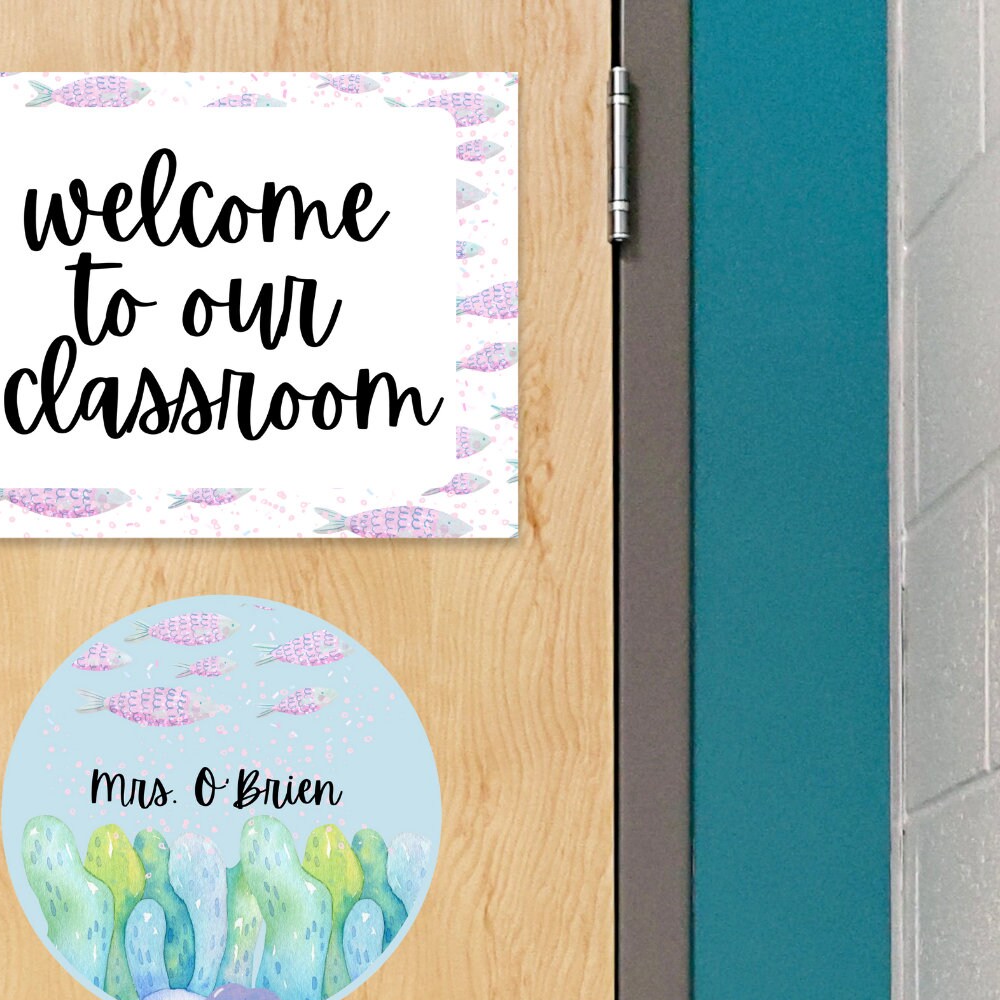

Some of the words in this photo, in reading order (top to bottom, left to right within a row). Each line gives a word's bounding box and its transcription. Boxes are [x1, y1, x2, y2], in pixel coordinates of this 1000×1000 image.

[23, 147, 391, 252] welcome
[64, 251, 158, 347] to
[182, 275, 343, 351] our
[3, 334, 445, 441] classroom
[91, 768, 177, 810] Mrs.
[194, 766, 343, 810] O'Brien
